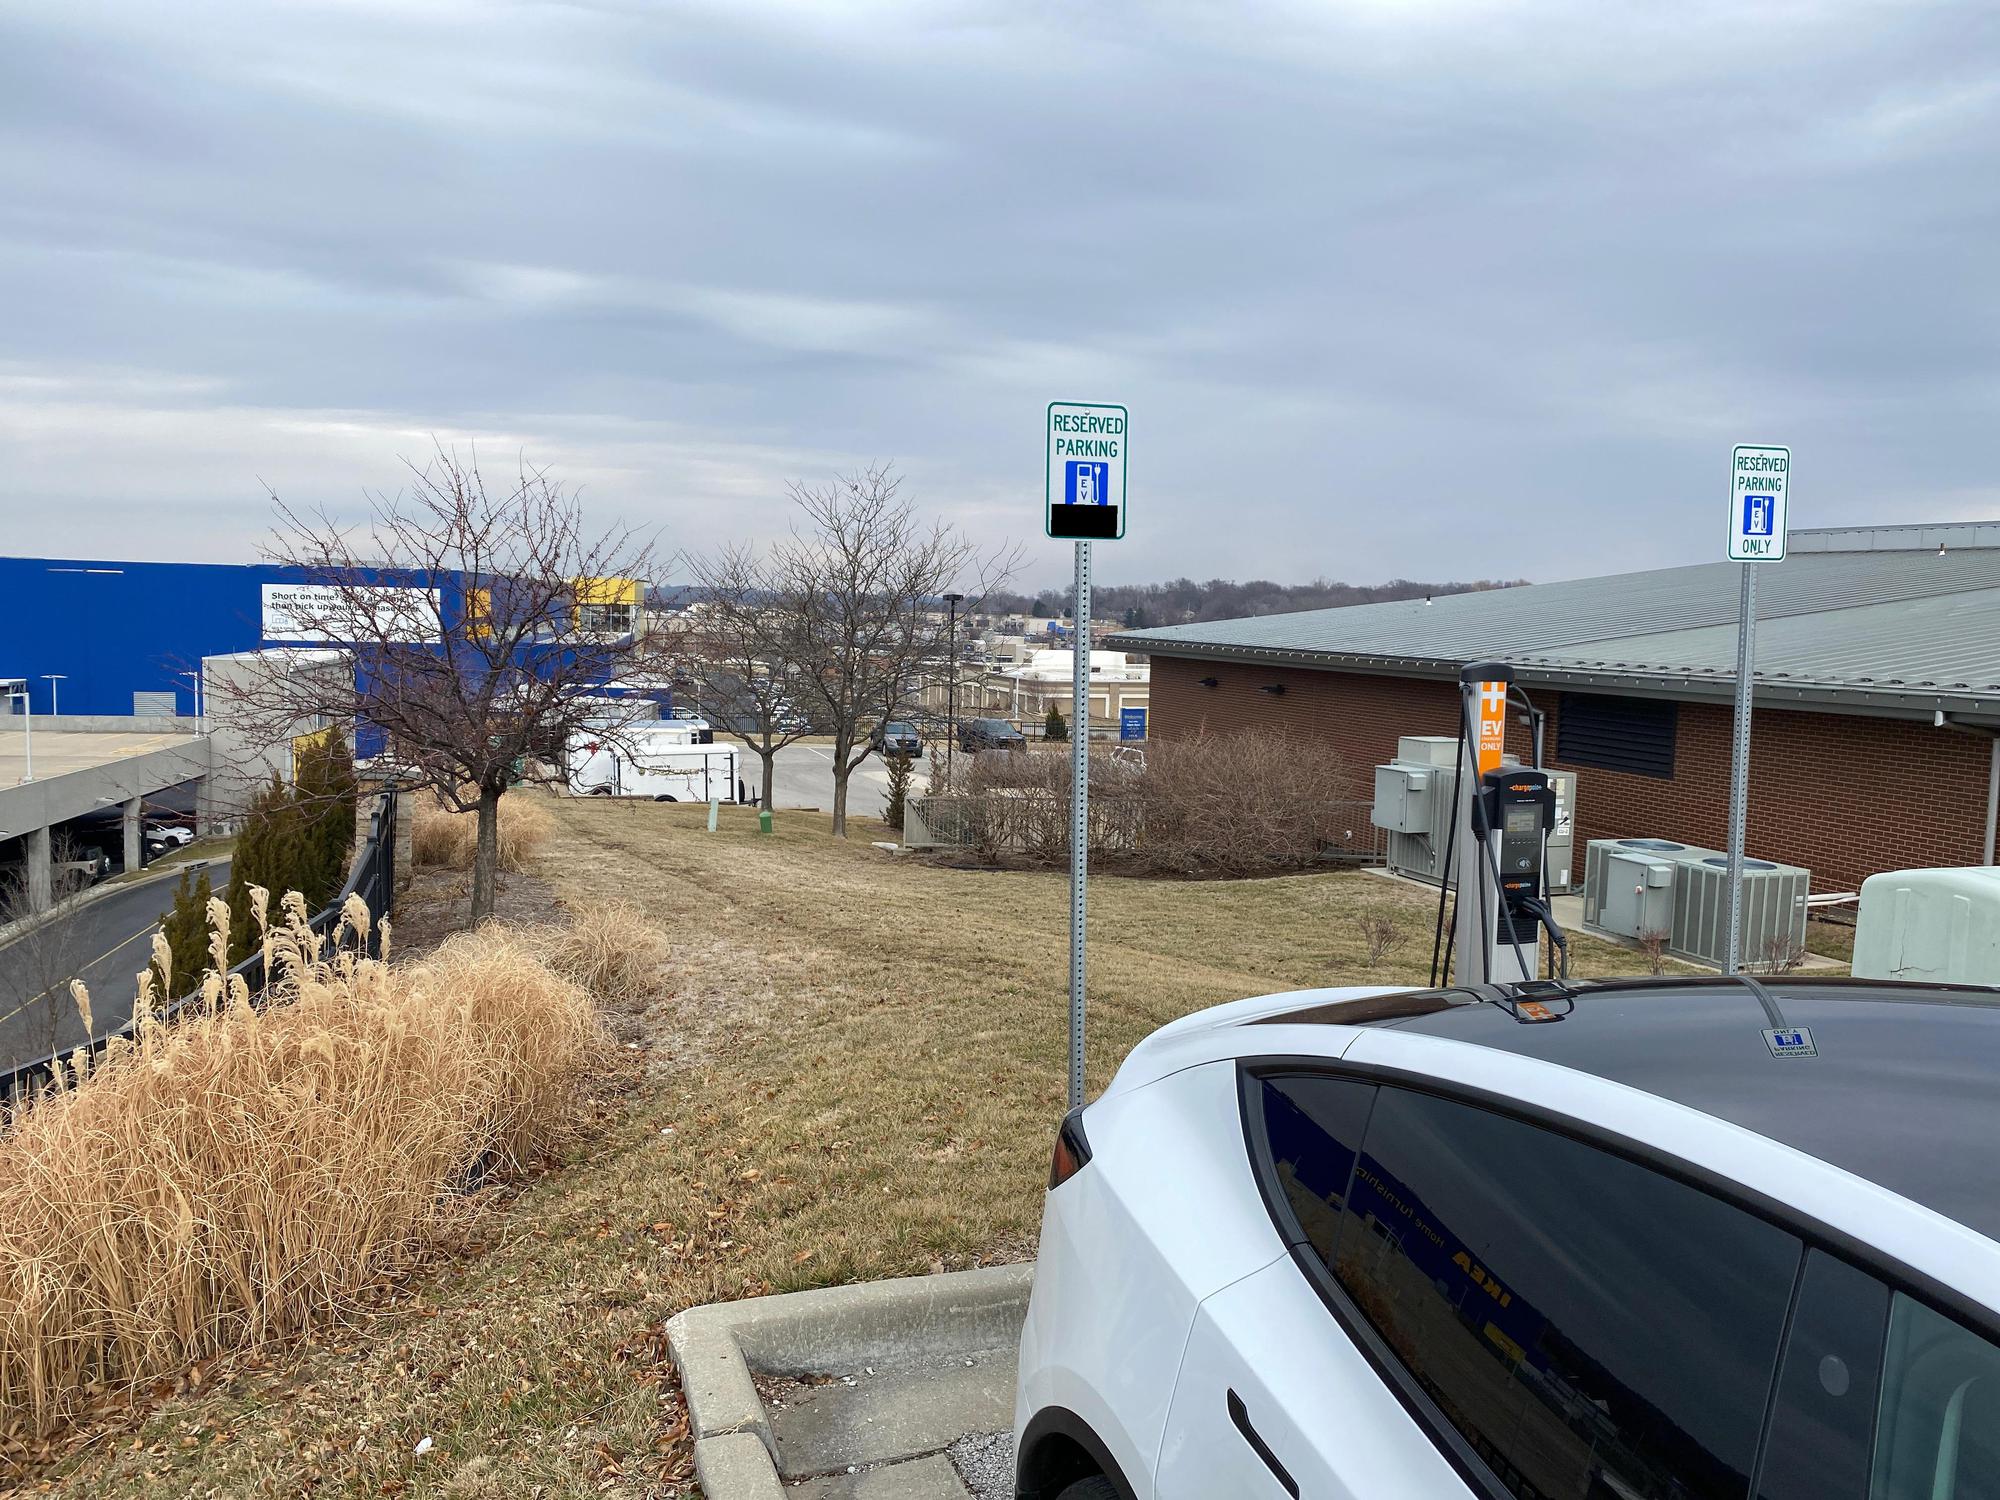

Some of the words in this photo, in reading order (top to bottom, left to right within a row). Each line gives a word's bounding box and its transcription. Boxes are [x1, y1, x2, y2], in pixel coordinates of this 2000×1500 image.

[1053, 414, 1124, 434] RESERVED
[1056, 438, 1118, 458] PARKING
[1737, 456, 1787, 472] RESERVED
[1738, 476, 1782, 492] PARKING
[1742, 539, 1771, 554] ONLY
[271, 592, 297, 600] Short
[295, 602, 314, 610] pick
[1482, 720, 1502, 736] EV
[1480, 742, 1501, 751] ONLY
